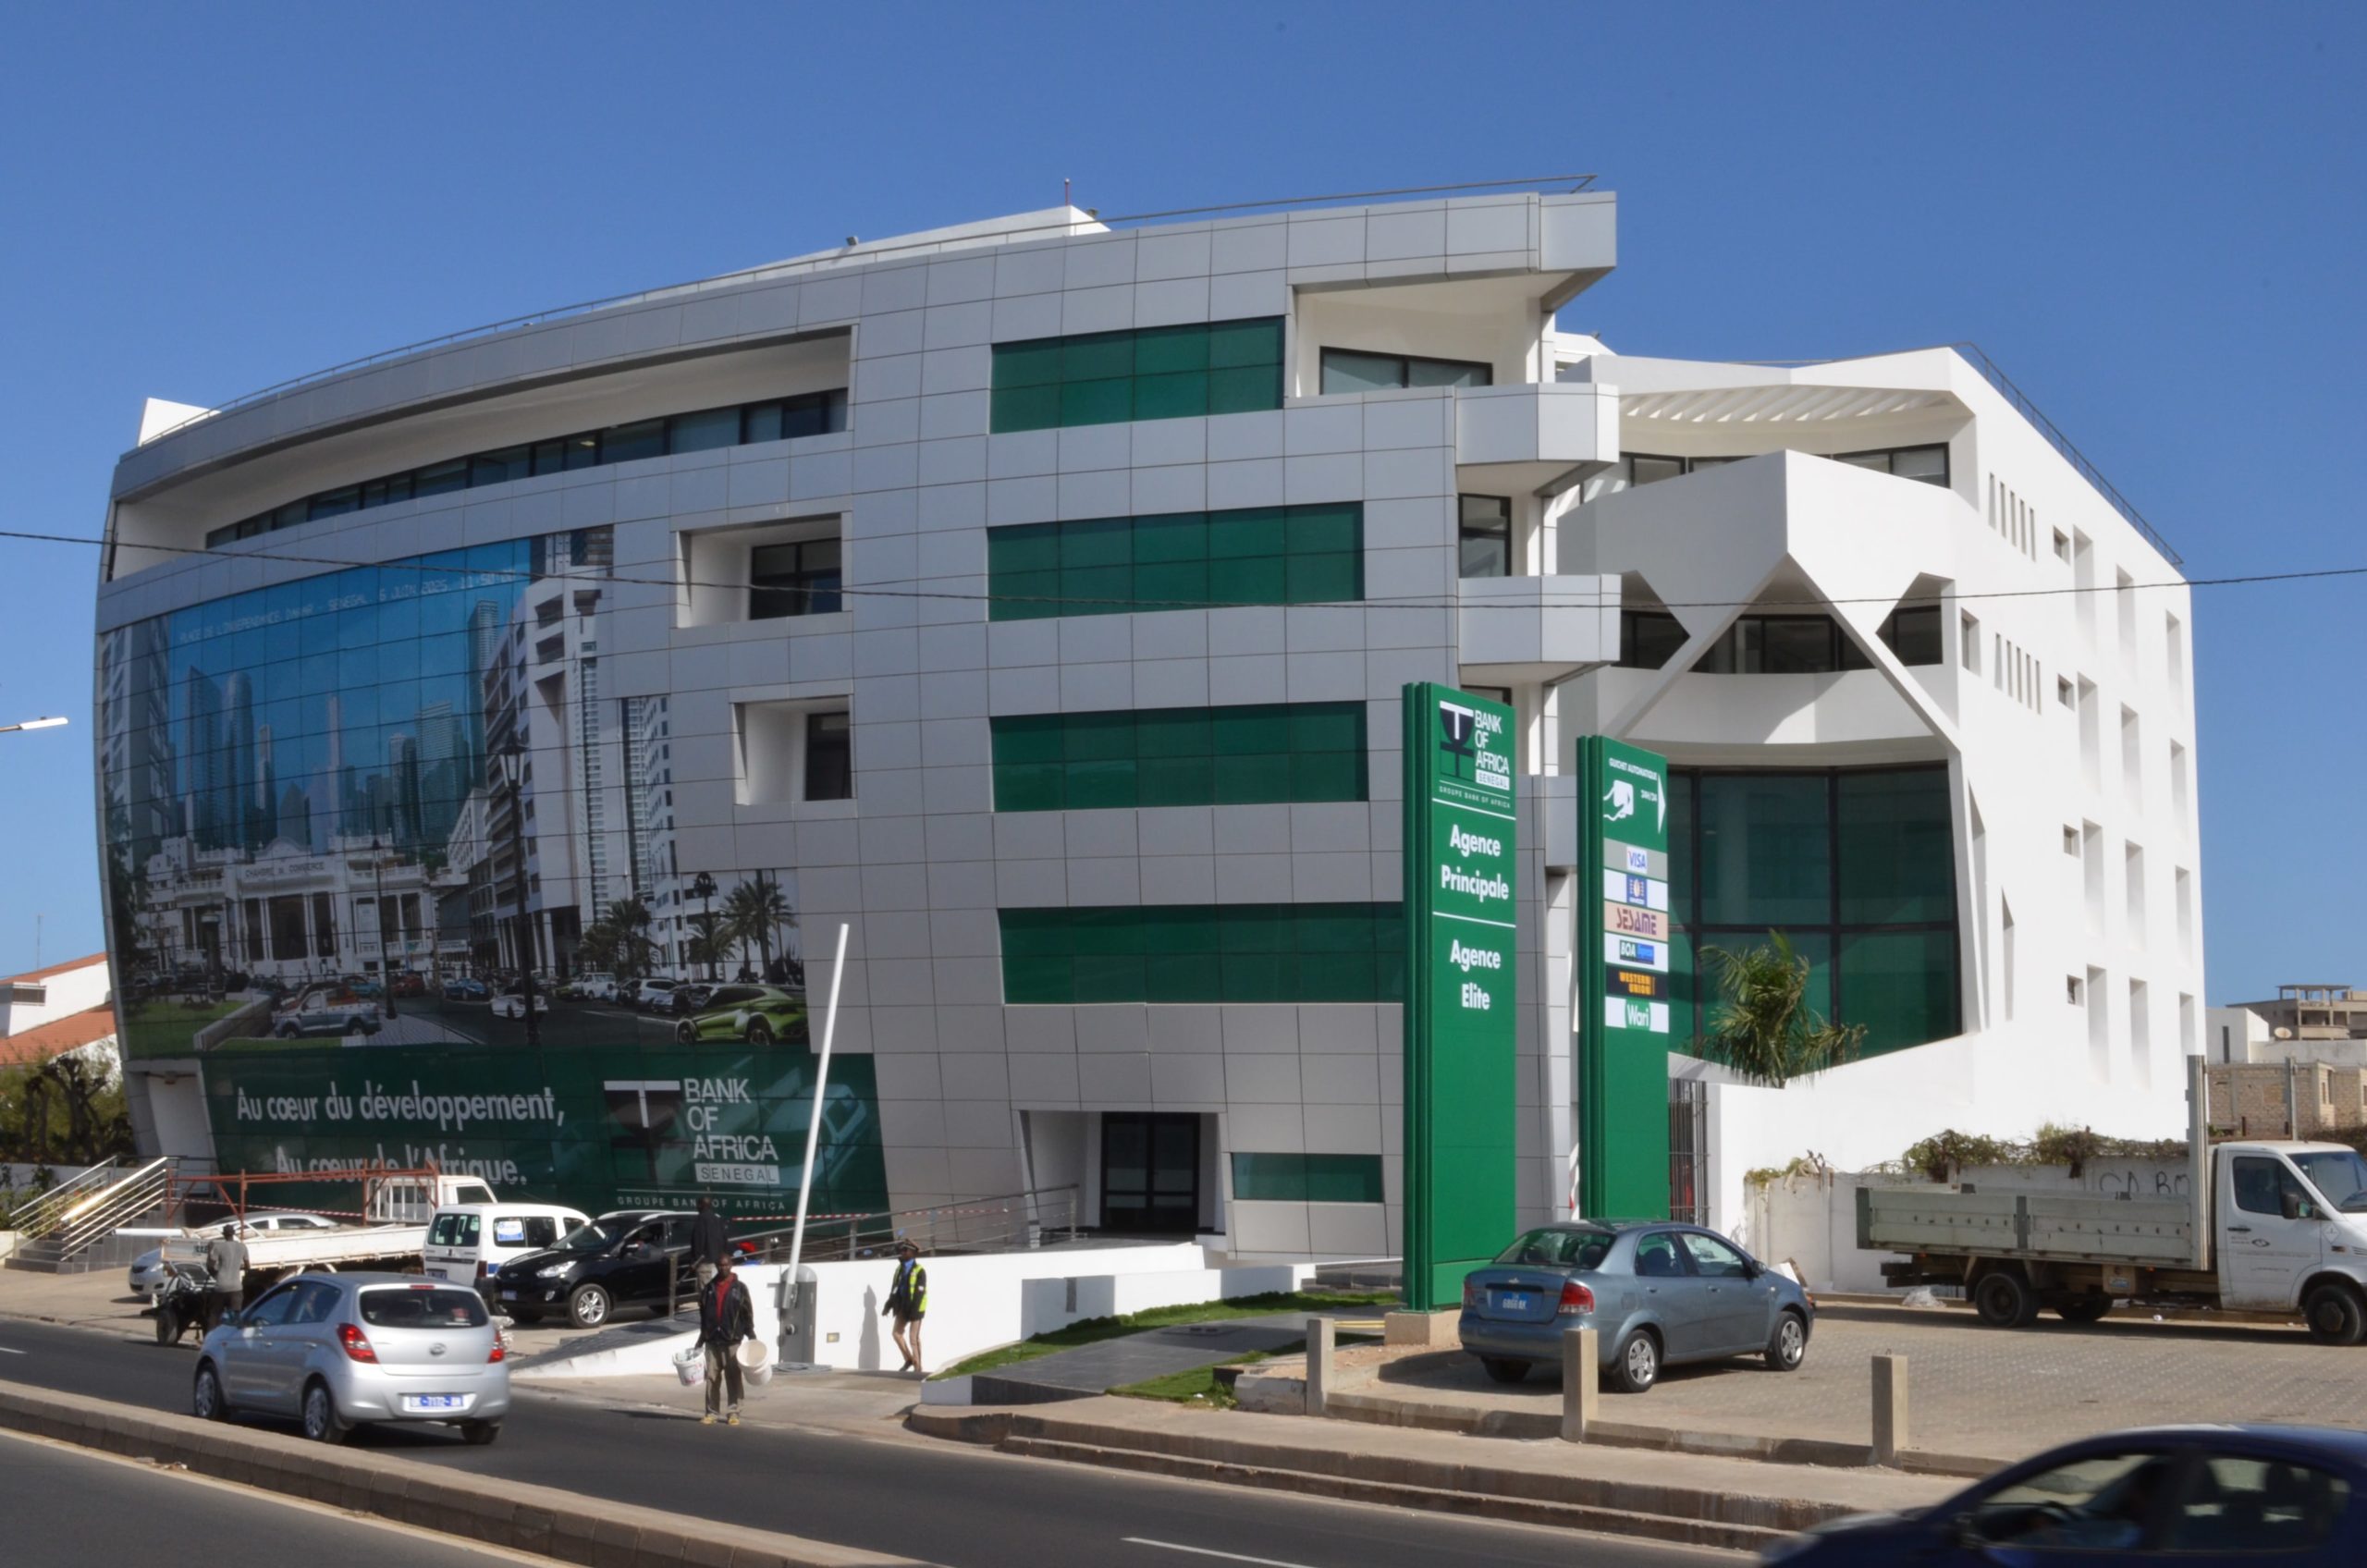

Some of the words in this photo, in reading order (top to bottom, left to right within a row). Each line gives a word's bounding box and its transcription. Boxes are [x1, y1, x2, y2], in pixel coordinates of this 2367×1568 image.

[1475, 709, 1502, 734] BANK
[1475, 729, 1489, 749] OF
[1476, 750, 1510, 775] AFRICA
[1450, 824, 1502, 857] Agence
[1627, 851, 1647, 868] VISA
[1441, 864, 1509, 902] Principale
[1450, 938, 1502, 972] Agence
[1621, 941, 1637, 959] BOA
[1461, 982, 1490, 1011] Elite
[1627, 1003, 1650, 1027] Wari
[683, 1078, 751, 1104] BANK
[237, 1086, 263, 1121] Au
[267, 1096, 319, 1121] cœur
[325, 1080, 353, 1121] du
[360, 1080, 564, 1132] développement,
[687, 1106, 718, 1131] OF
[693, 1135, 779, 1161] AFRICA
[701, 1165, 778, 1182] SENEGAL
[617, 1196, 666, 1207] GROUPE
[673, 1197, 700, 1207] BAN
[711, 1199, 728, 1208] OF
[736, 1199, 786, 1211] AFRICA
